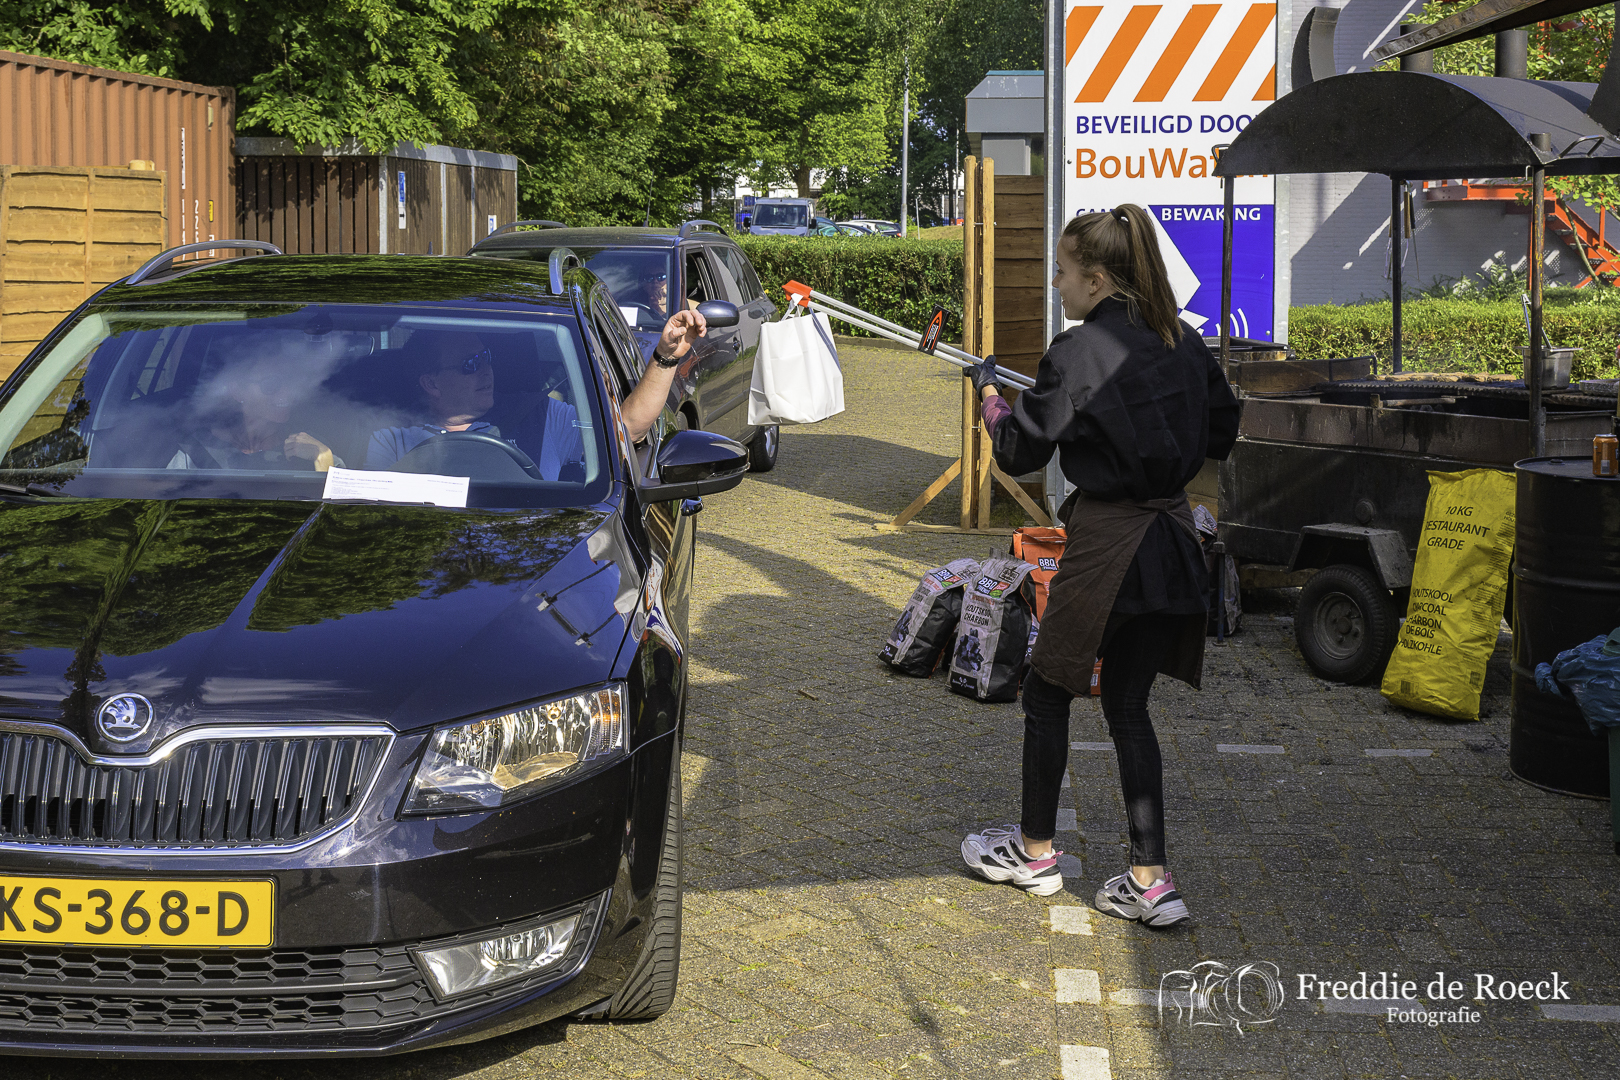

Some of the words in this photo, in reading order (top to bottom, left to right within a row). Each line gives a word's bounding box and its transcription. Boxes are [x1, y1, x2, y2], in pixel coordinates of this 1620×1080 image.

[1076, 115, 1193, 134] BEVEILIGD
[1200, 114, 1256, 133] DOO
[1076, 147, 1268, 179] BouWat
[1161, 207, 1261, 221] BEWAKNG
[1445, 506, 1457, 515] 10
[1457, 506, 1474, 517] KG
[1427, 536, 1465, 550] GRADE
[1413, 588, 1453, 603] OUTSKOOL
[1405, 625, 1415, 635] DE
[1415, 626, 1435, 639] BOIS
[0, 886, 249, 936] KS-368-D
